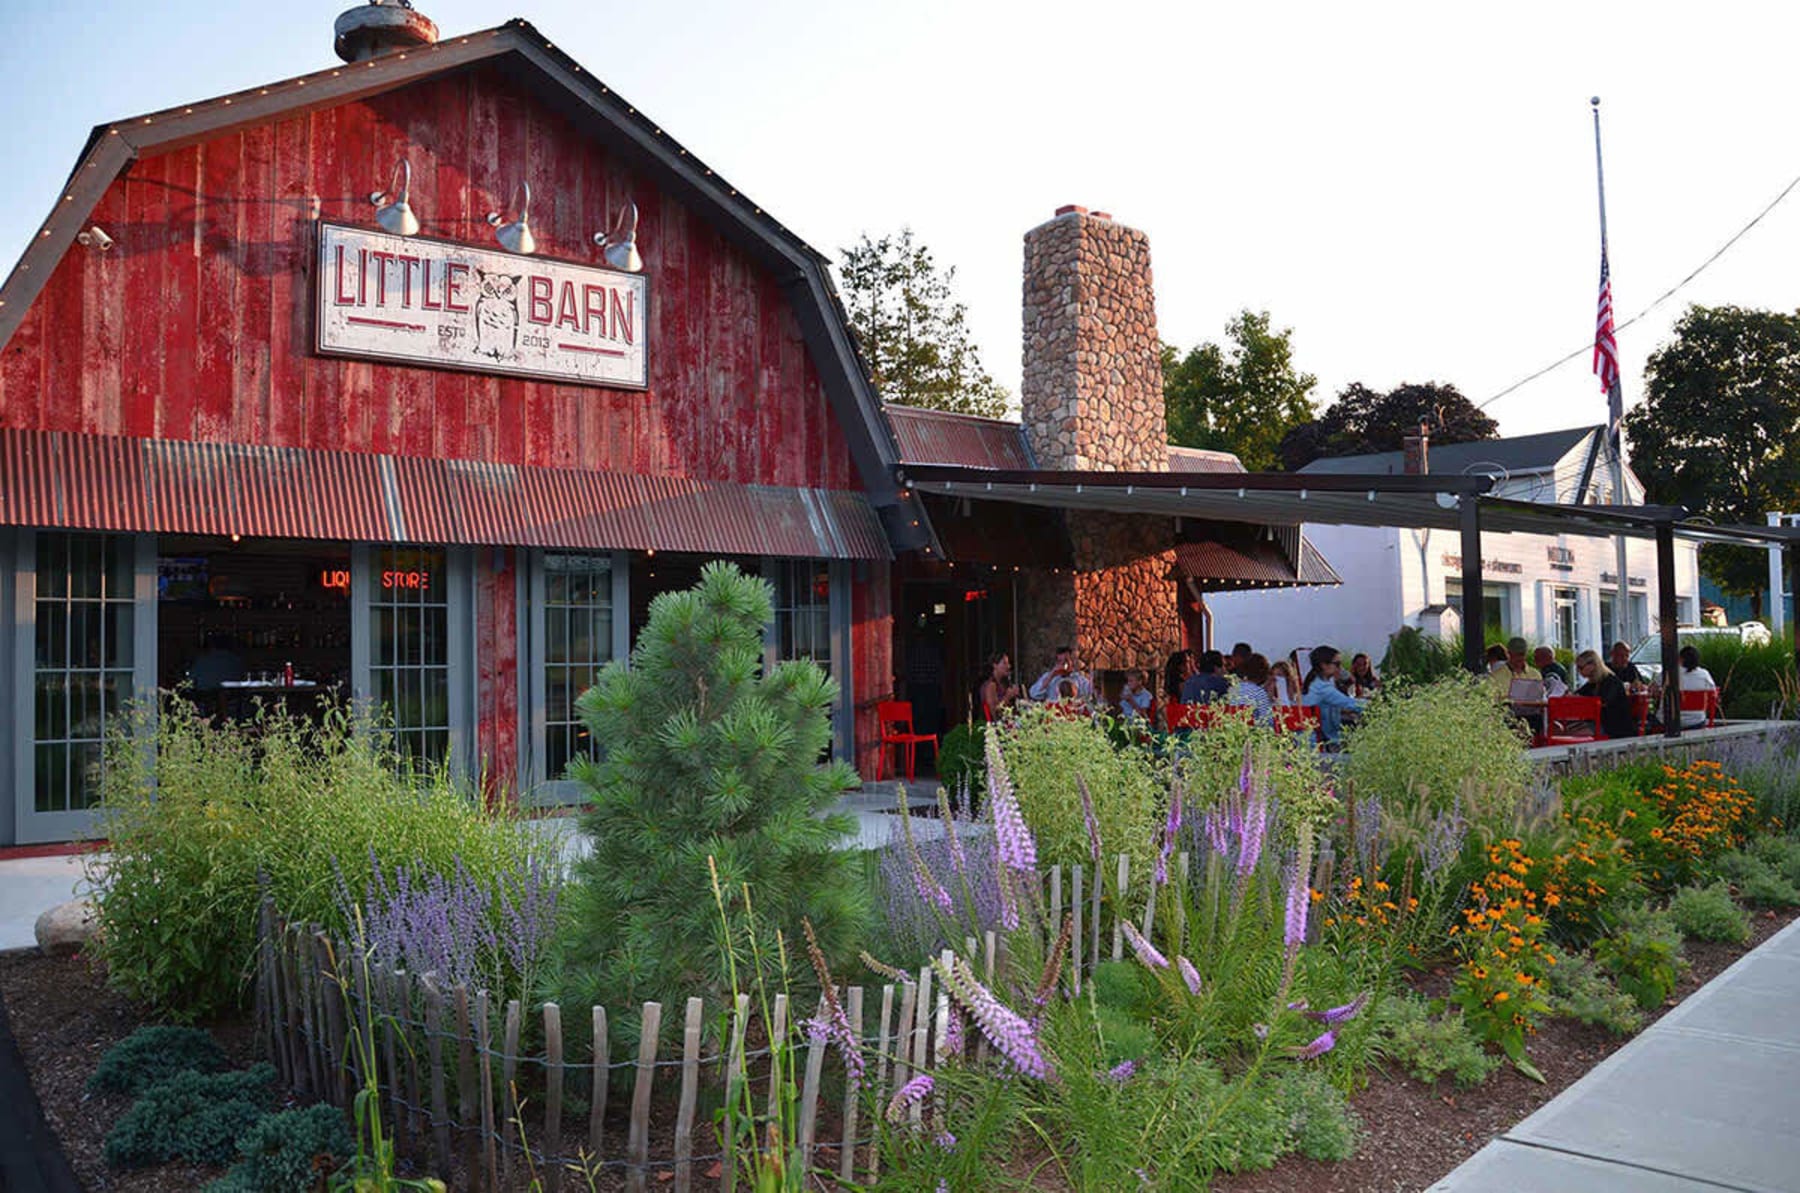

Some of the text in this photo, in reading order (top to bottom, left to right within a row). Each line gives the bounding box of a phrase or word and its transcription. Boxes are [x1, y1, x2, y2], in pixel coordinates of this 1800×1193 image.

[334, 244, 634, 346] LITTLE BARN
[522, 335, 550, 349] 2013
[382, 570, 430, 590] STORE
